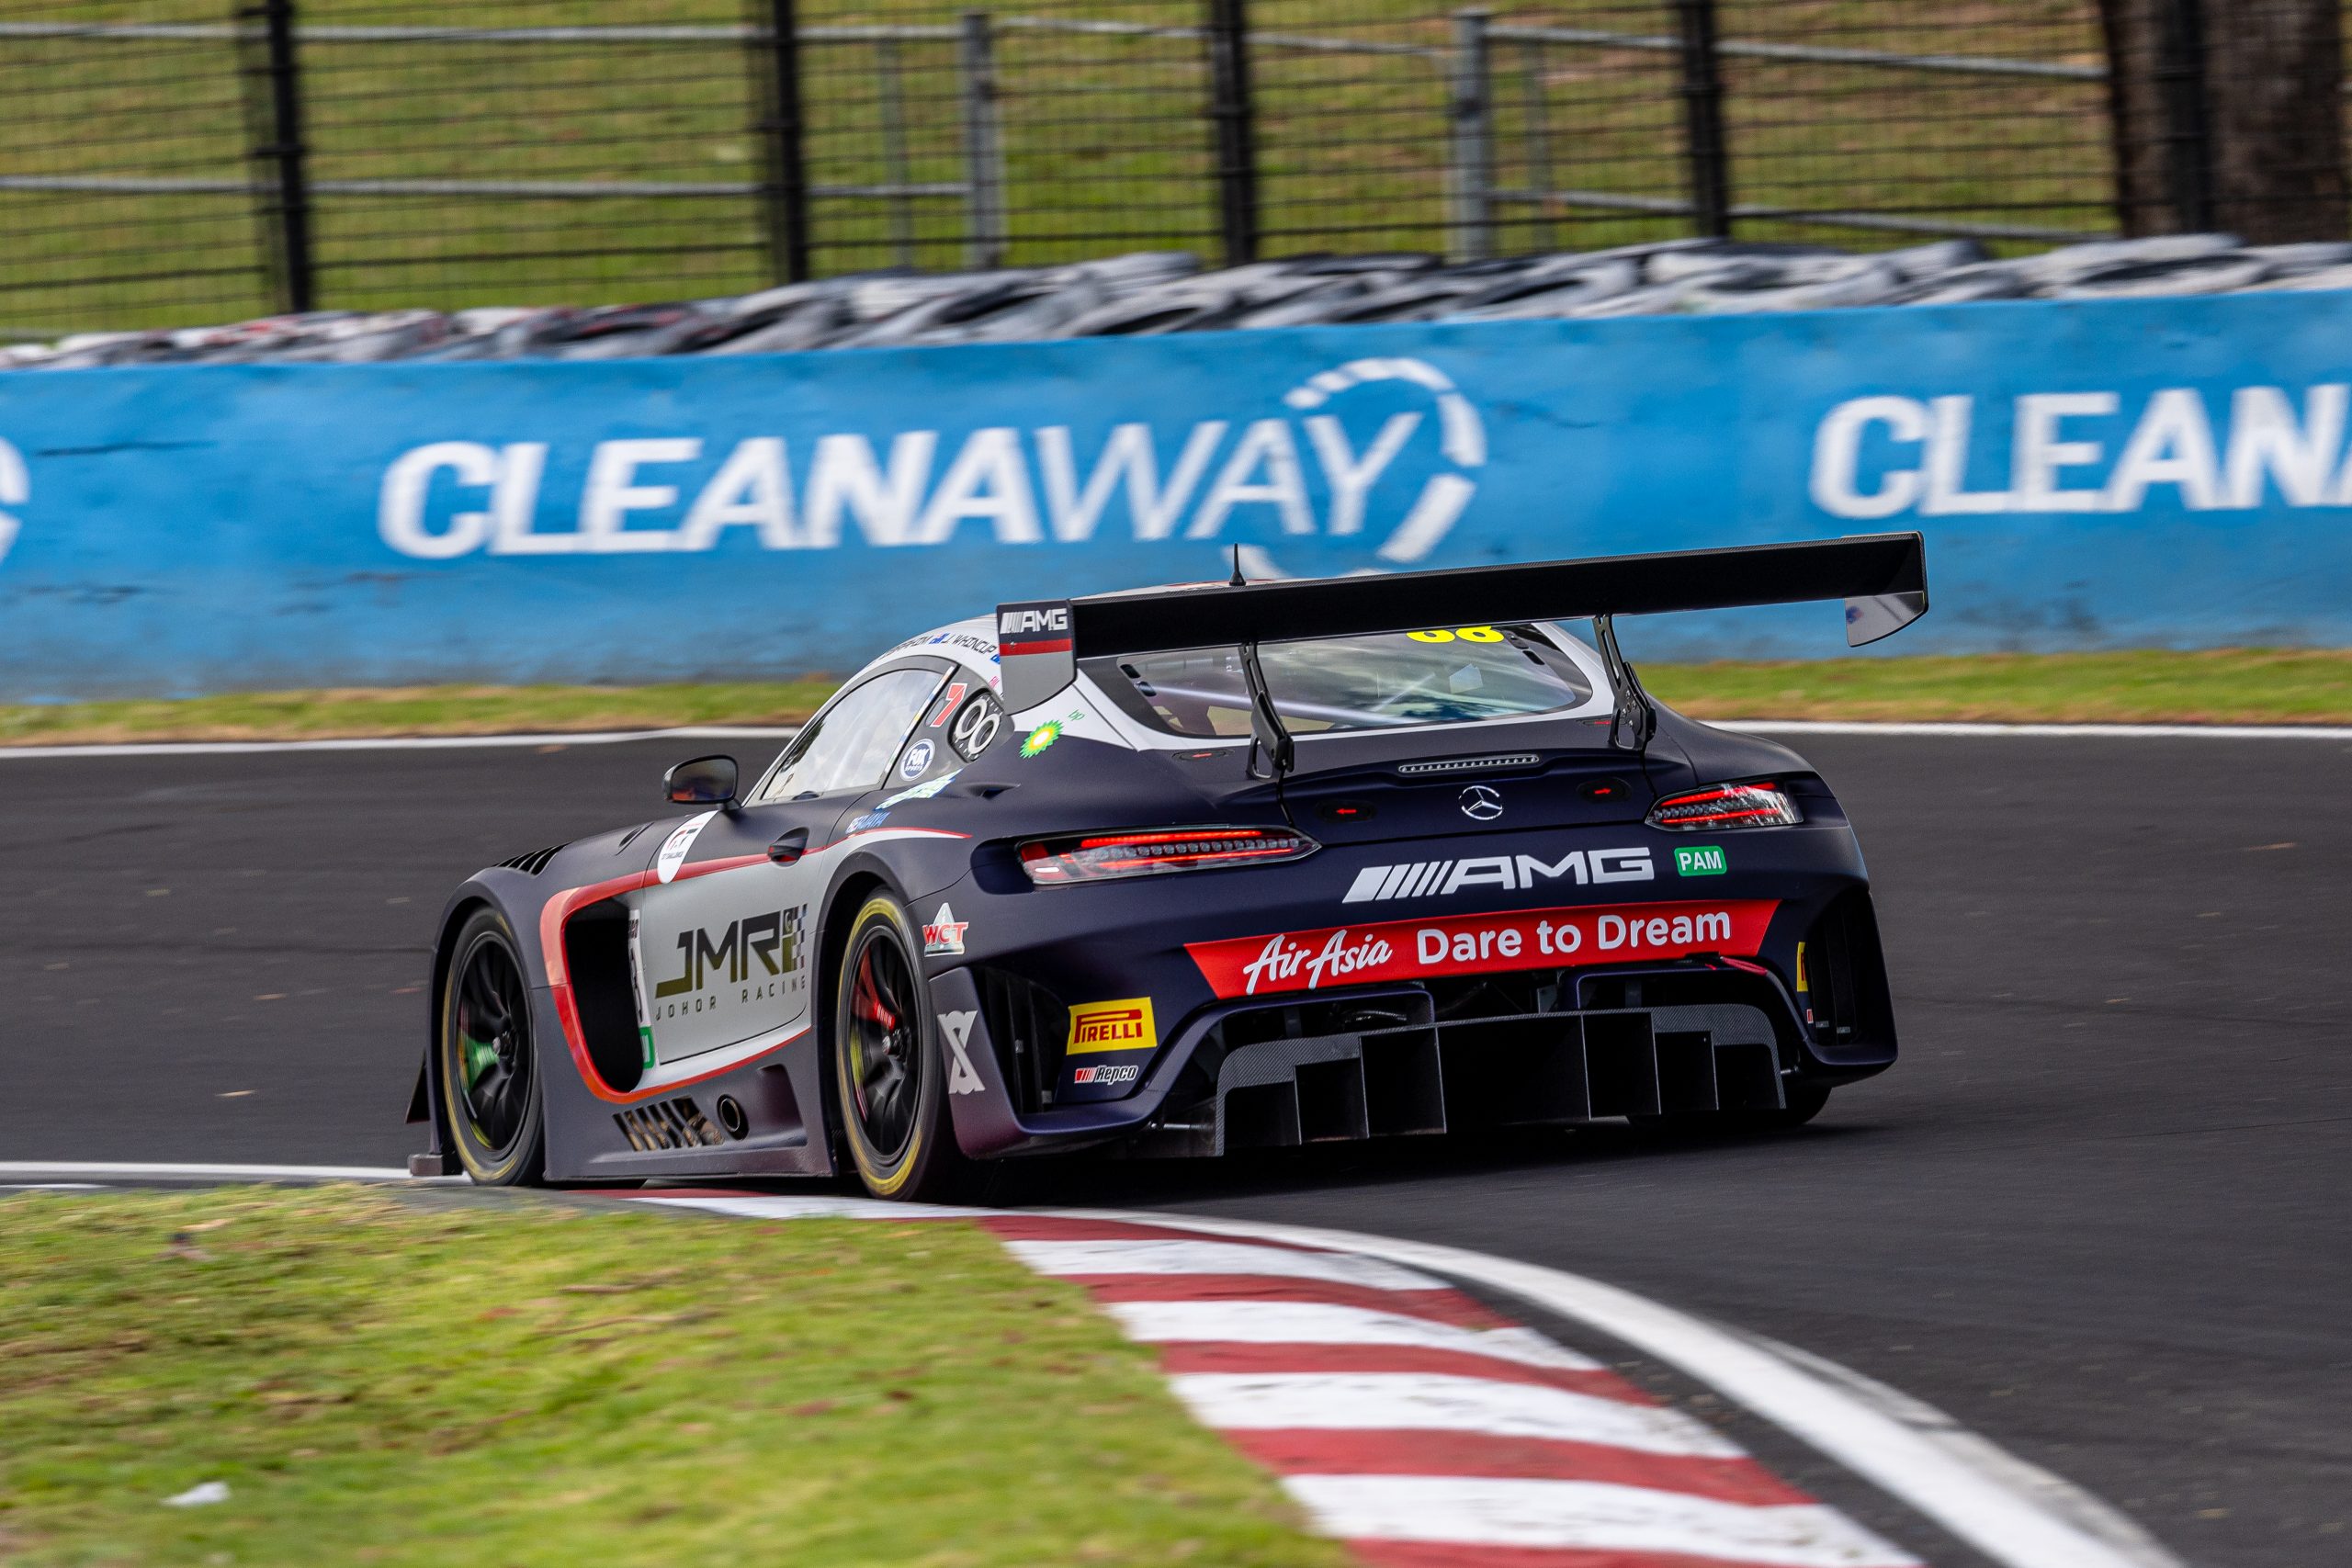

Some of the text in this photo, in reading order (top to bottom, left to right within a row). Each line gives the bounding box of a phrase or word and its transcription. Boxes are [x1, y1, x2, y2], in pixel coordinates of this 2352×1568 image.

[1809, 383, 2352, 520] CLEAN
[377, 412, 1423, 558] CLEANAWAY
[1019, 607, 1069, 632] AMG
[953, 634, 997, 654] WHINCUP
[907, 748, 931, 766] FOX
[1442, 846, 1655, 895] AMG
[1678, 851, 1723, 872] PAM
[922, 921, 968, 946] WCT
[1417, 924, 1522, 965] Dare
[1536, 919, 1581, 955] to
[1598, 911, 1731, 951] Dream
[655, 995, 717, 1021] JOHOR
[1073, 1009, 1143, 1043] PIRELLI
[1094, 1066, 1138, 1085] Repco
